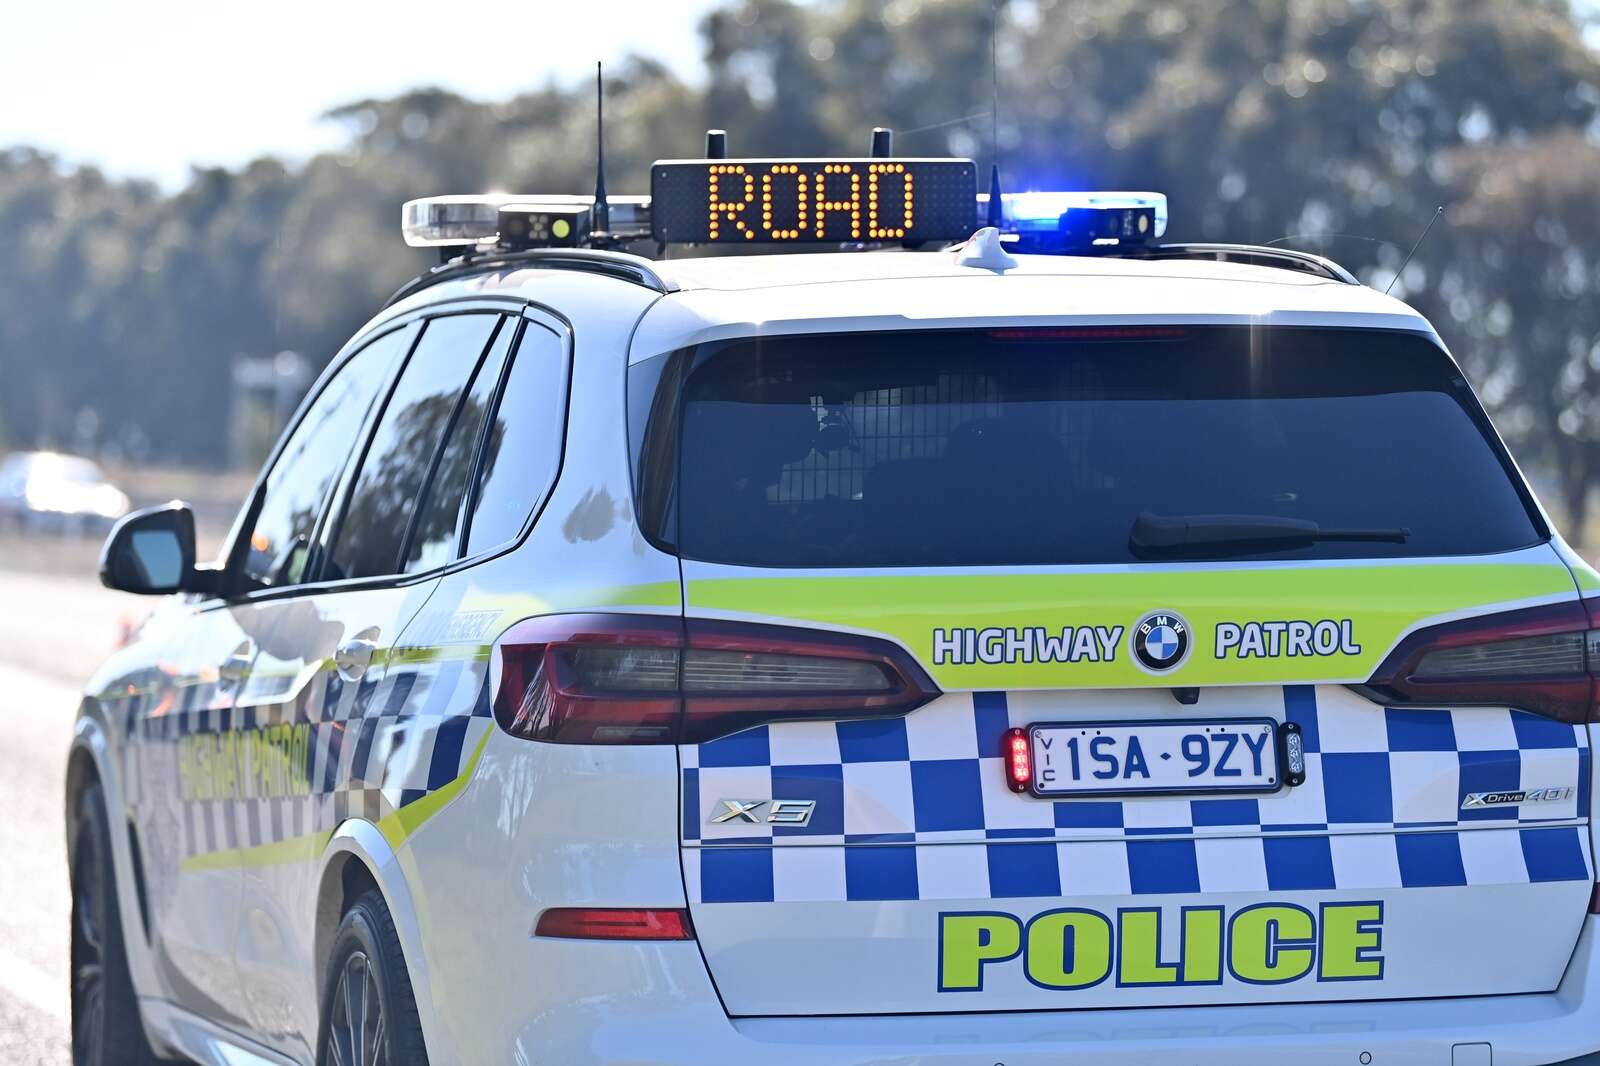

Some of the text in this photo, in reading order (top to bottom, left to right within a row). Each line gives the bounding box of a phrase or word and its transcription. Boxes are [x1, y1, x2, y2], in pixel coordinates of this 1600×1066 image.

[709, 164, 913, 240] ROAD
[933, 620, 1361, 665] HIGHWAY PATROL
[1140, 616, 1184, 635] BMW
[1040, 737, 1056, 782] VIC
[711, 799, 816, 824] X5
[937, 900, 1385, 993] POLICE
